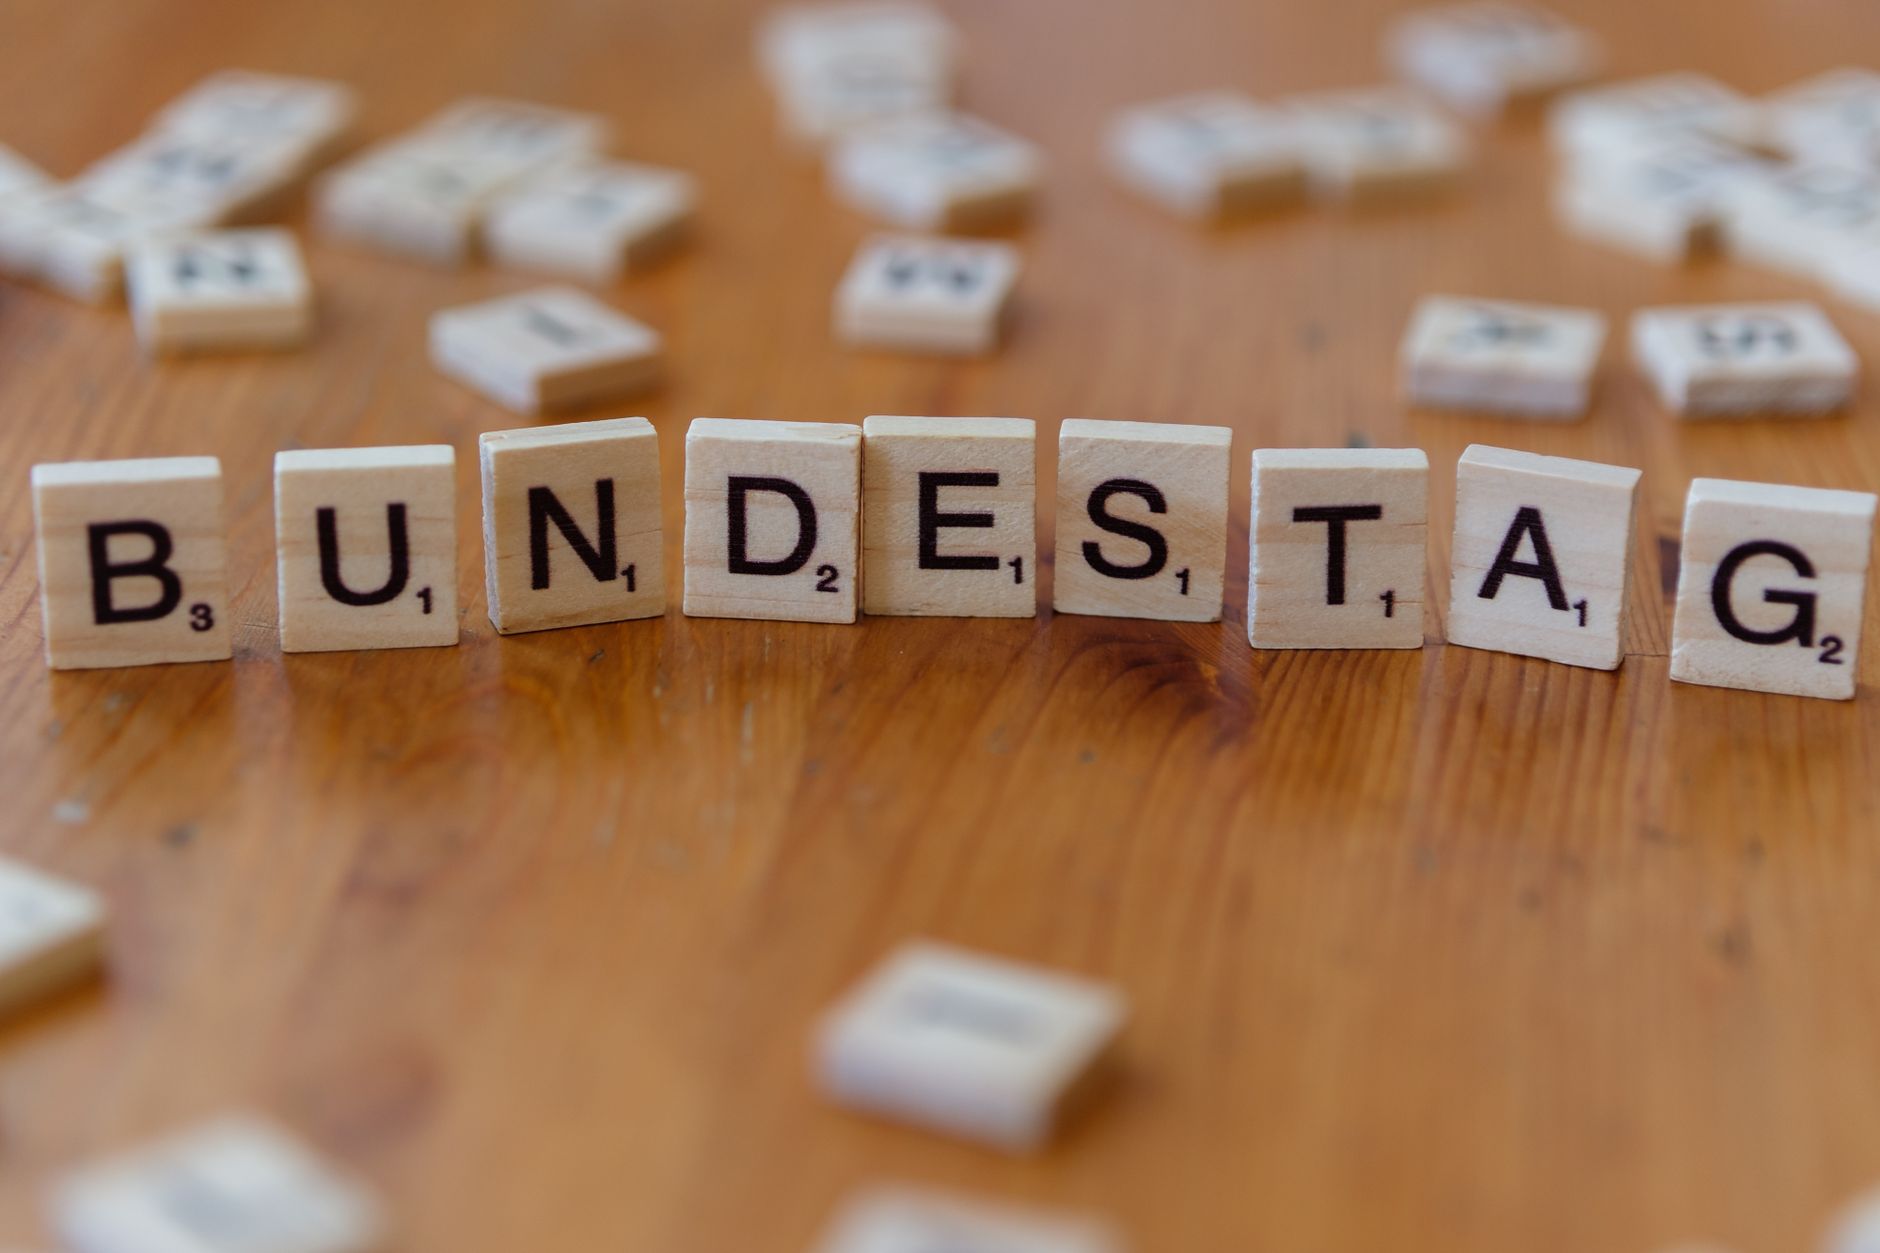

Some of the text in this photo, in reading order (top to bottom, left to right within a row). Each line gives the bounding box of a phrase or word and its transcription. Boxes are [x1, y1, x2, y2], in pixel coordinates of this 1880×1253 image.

[86, 472, 1818, 648] BUNDESTAG
[1007, 555, 1024, 585] 1
[619, 563, 637, 593] 1
[815, 564, 840, 593] 2
[1174, 567, 1191, 597] 1
[416, 586, 433, 615] 1
[1379, 590, 1395, 618] 1
[1572, 599, 1589, 628] 1
[190, 603, 214, 632] 3
[1818, 635, 1843, 665] 2
